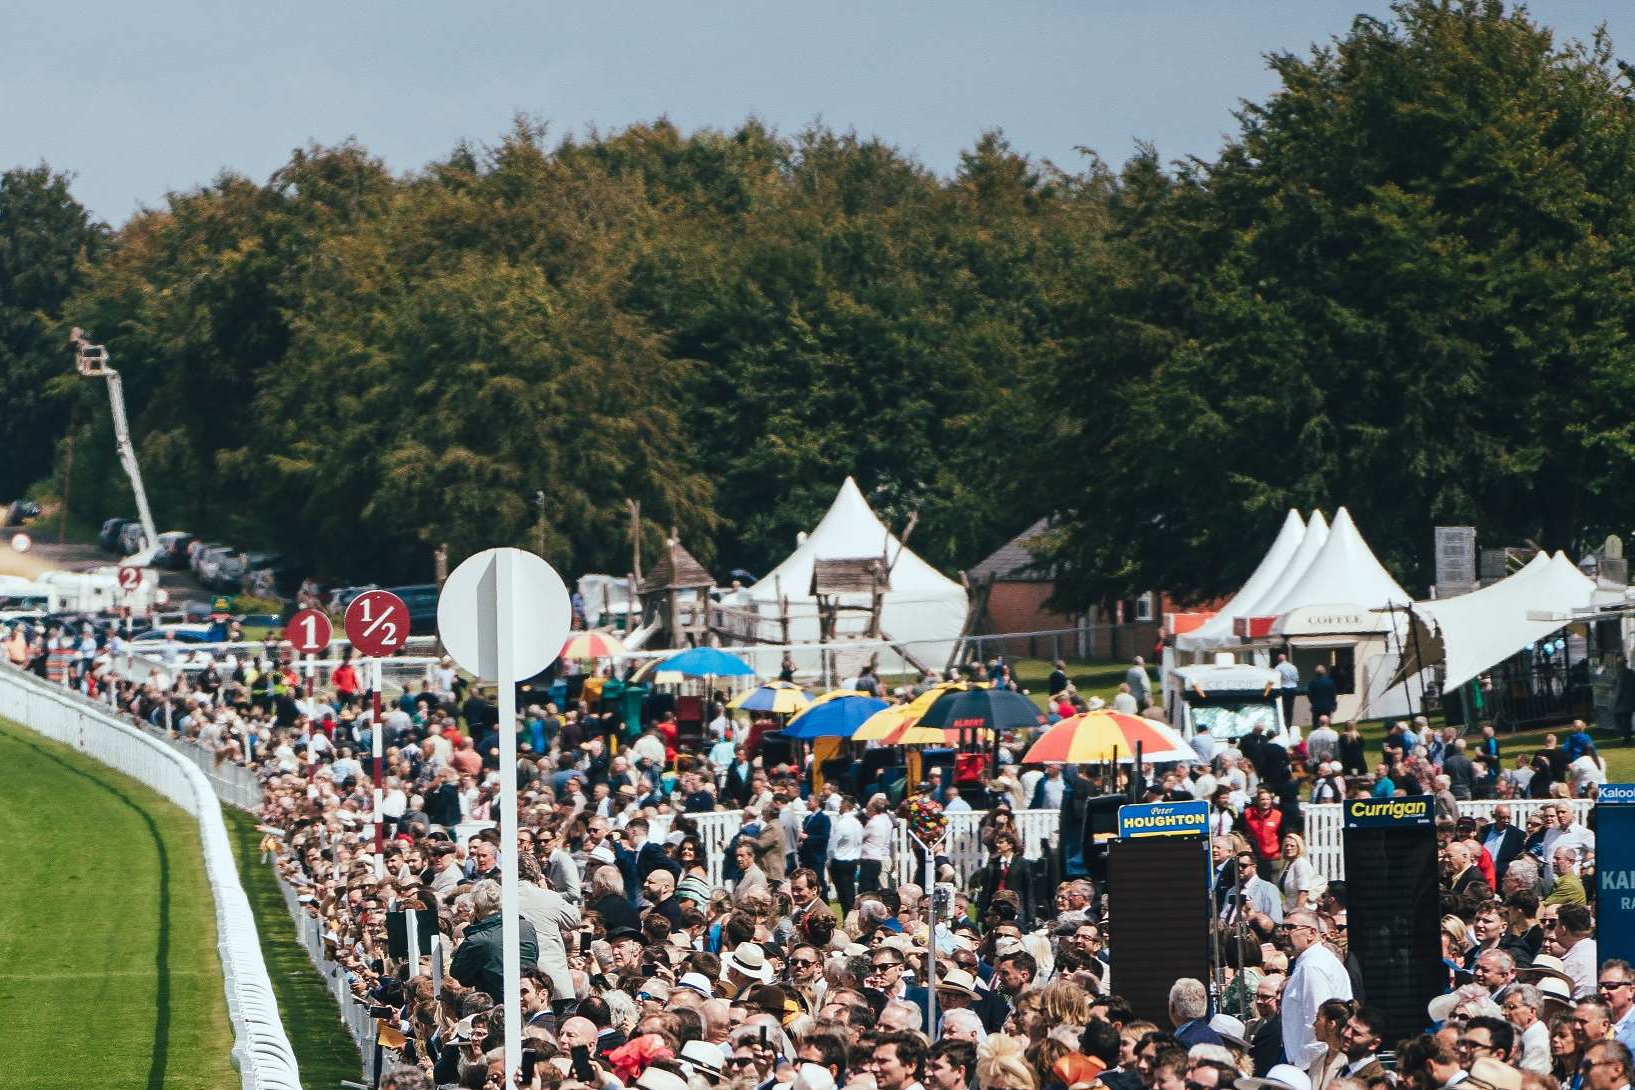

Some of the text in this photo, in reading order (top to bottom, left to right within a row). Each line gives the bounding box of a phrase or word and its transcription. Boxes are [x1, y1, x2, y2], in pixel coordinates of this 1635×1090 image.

[123, 567, 137, 589] 2
[300, 615, 319, 648] 1
[1599, 787, 1635, 799] Kaloo
[1151, 807, 1175, 815] Peter
[1351, 801, 1426, 819] Currigan
[1124, 814, 1205, 829] HOUGHTON
[1601, 871, 1635, 889] KA
